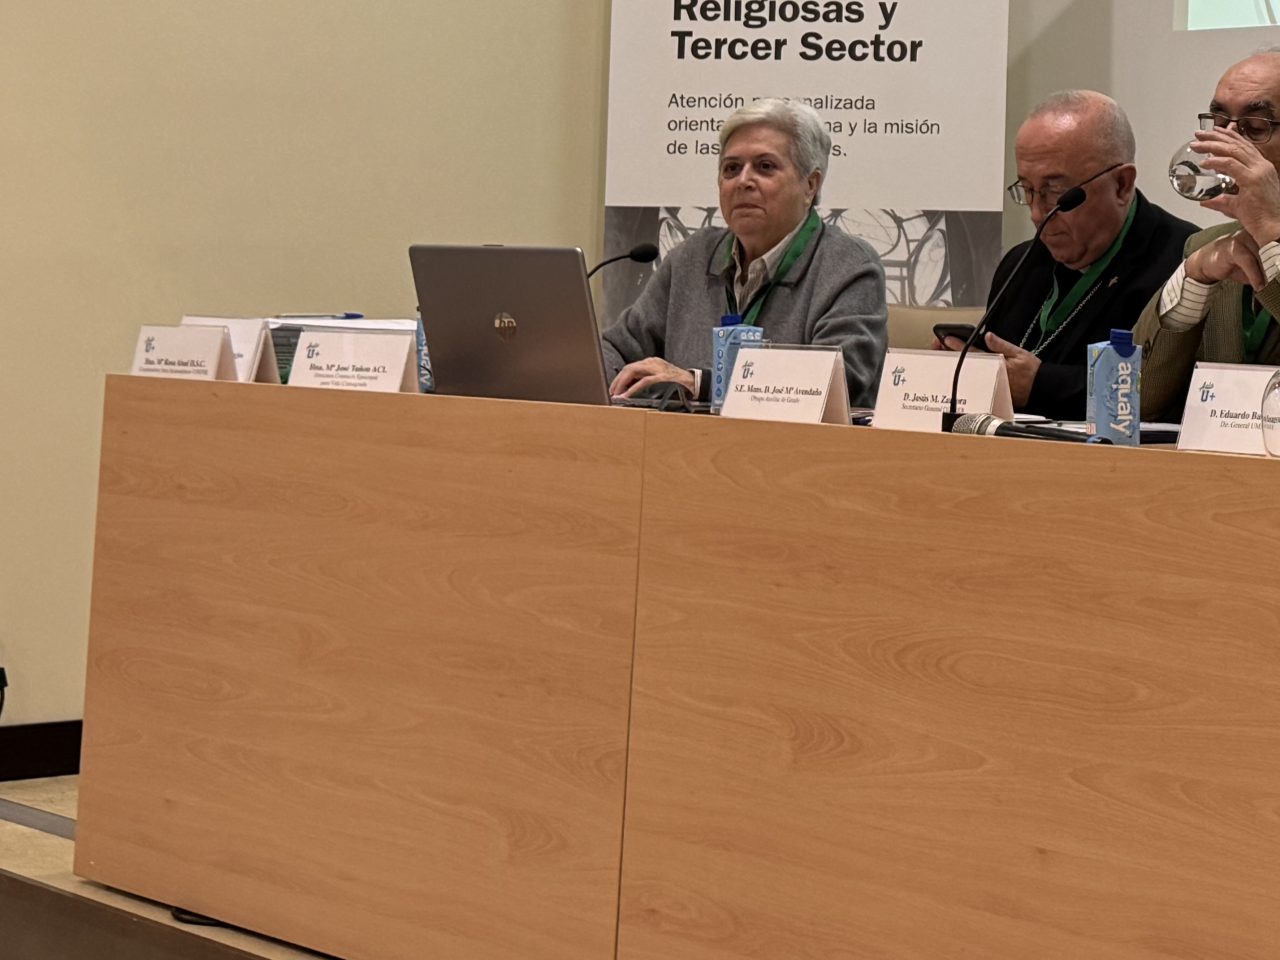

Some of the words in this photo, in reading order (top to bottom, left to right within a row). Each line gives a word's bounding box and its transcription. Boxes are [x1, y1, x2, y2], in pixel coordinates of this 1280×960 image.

[878, 1, 898, 30] y
[671, 31, 788, 61] Tercer
[799, 32, 923, 62] Sector
[667, 93, 744, 110] Atención
[848, 120, 858, 137] y
[863, 119, 878, 134] la
[884, 119, 941, 135] misión
[666, 140, 688, 155] de
[695, 140, 720, 155] las
[1110, 362, 1133, 433] aqualy
[1219, 410, 1250, 420] Eduardo
